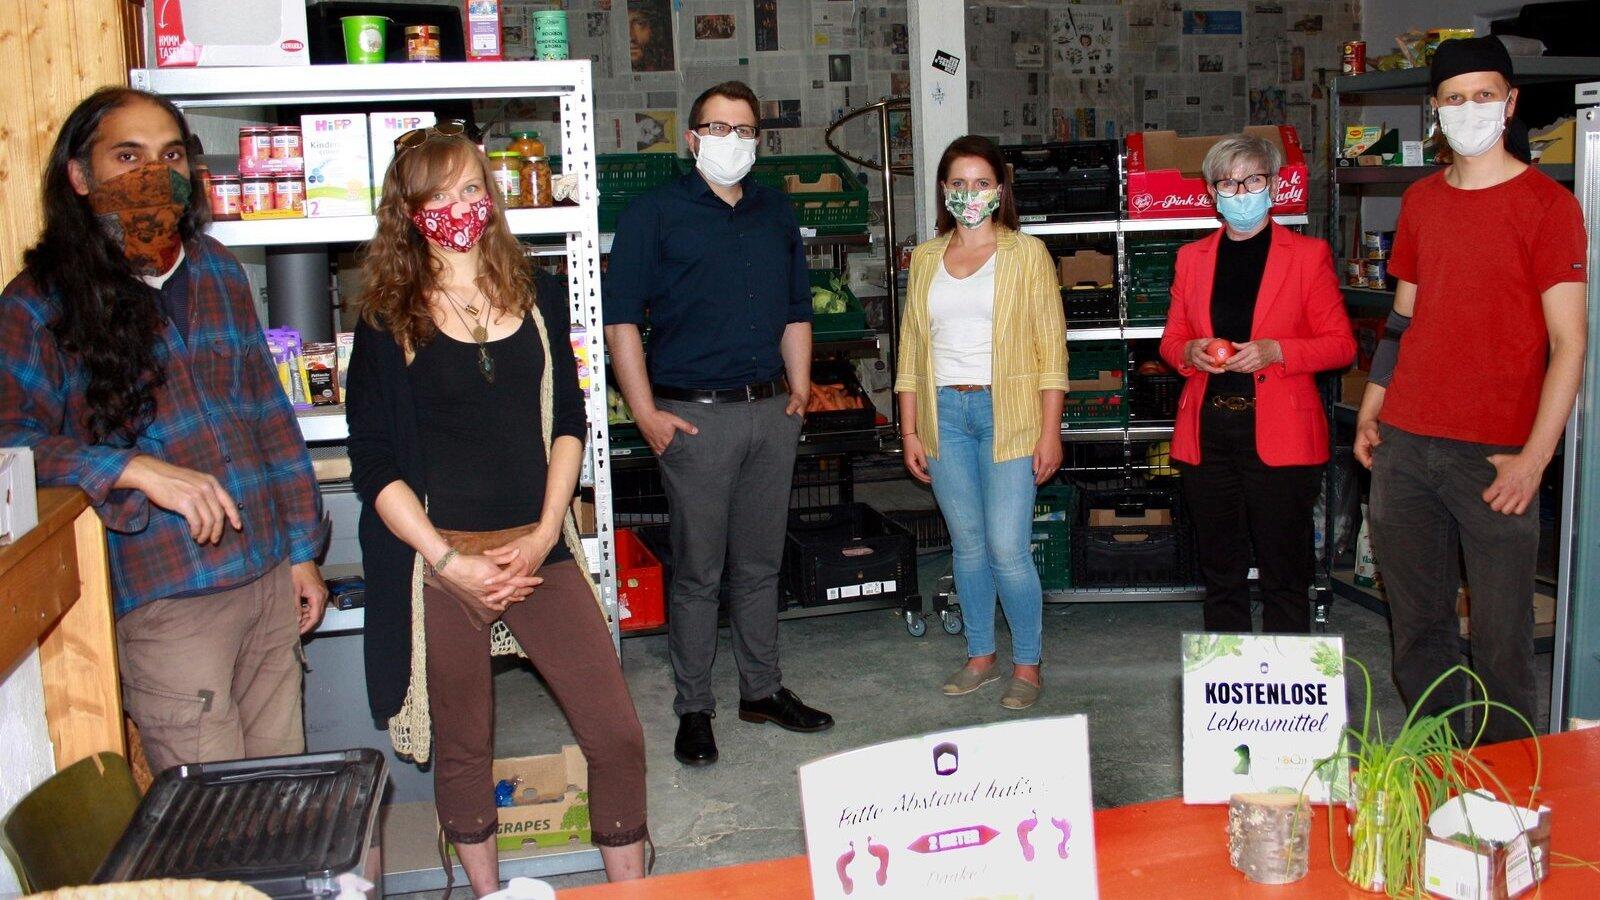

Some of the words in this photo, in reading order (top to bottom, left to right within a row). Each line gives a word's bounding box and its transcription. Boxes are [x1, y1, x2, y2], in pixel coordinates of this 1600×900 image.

[1276, 171, 1301, 192] ink
[310, 201, 320, 215] 2
[1205, 682, 1328, 706] KOSTENLOSE
[1207, 710, 1329, 733] Lebensmittel
[497, 819, 551, 835] GRAPES
